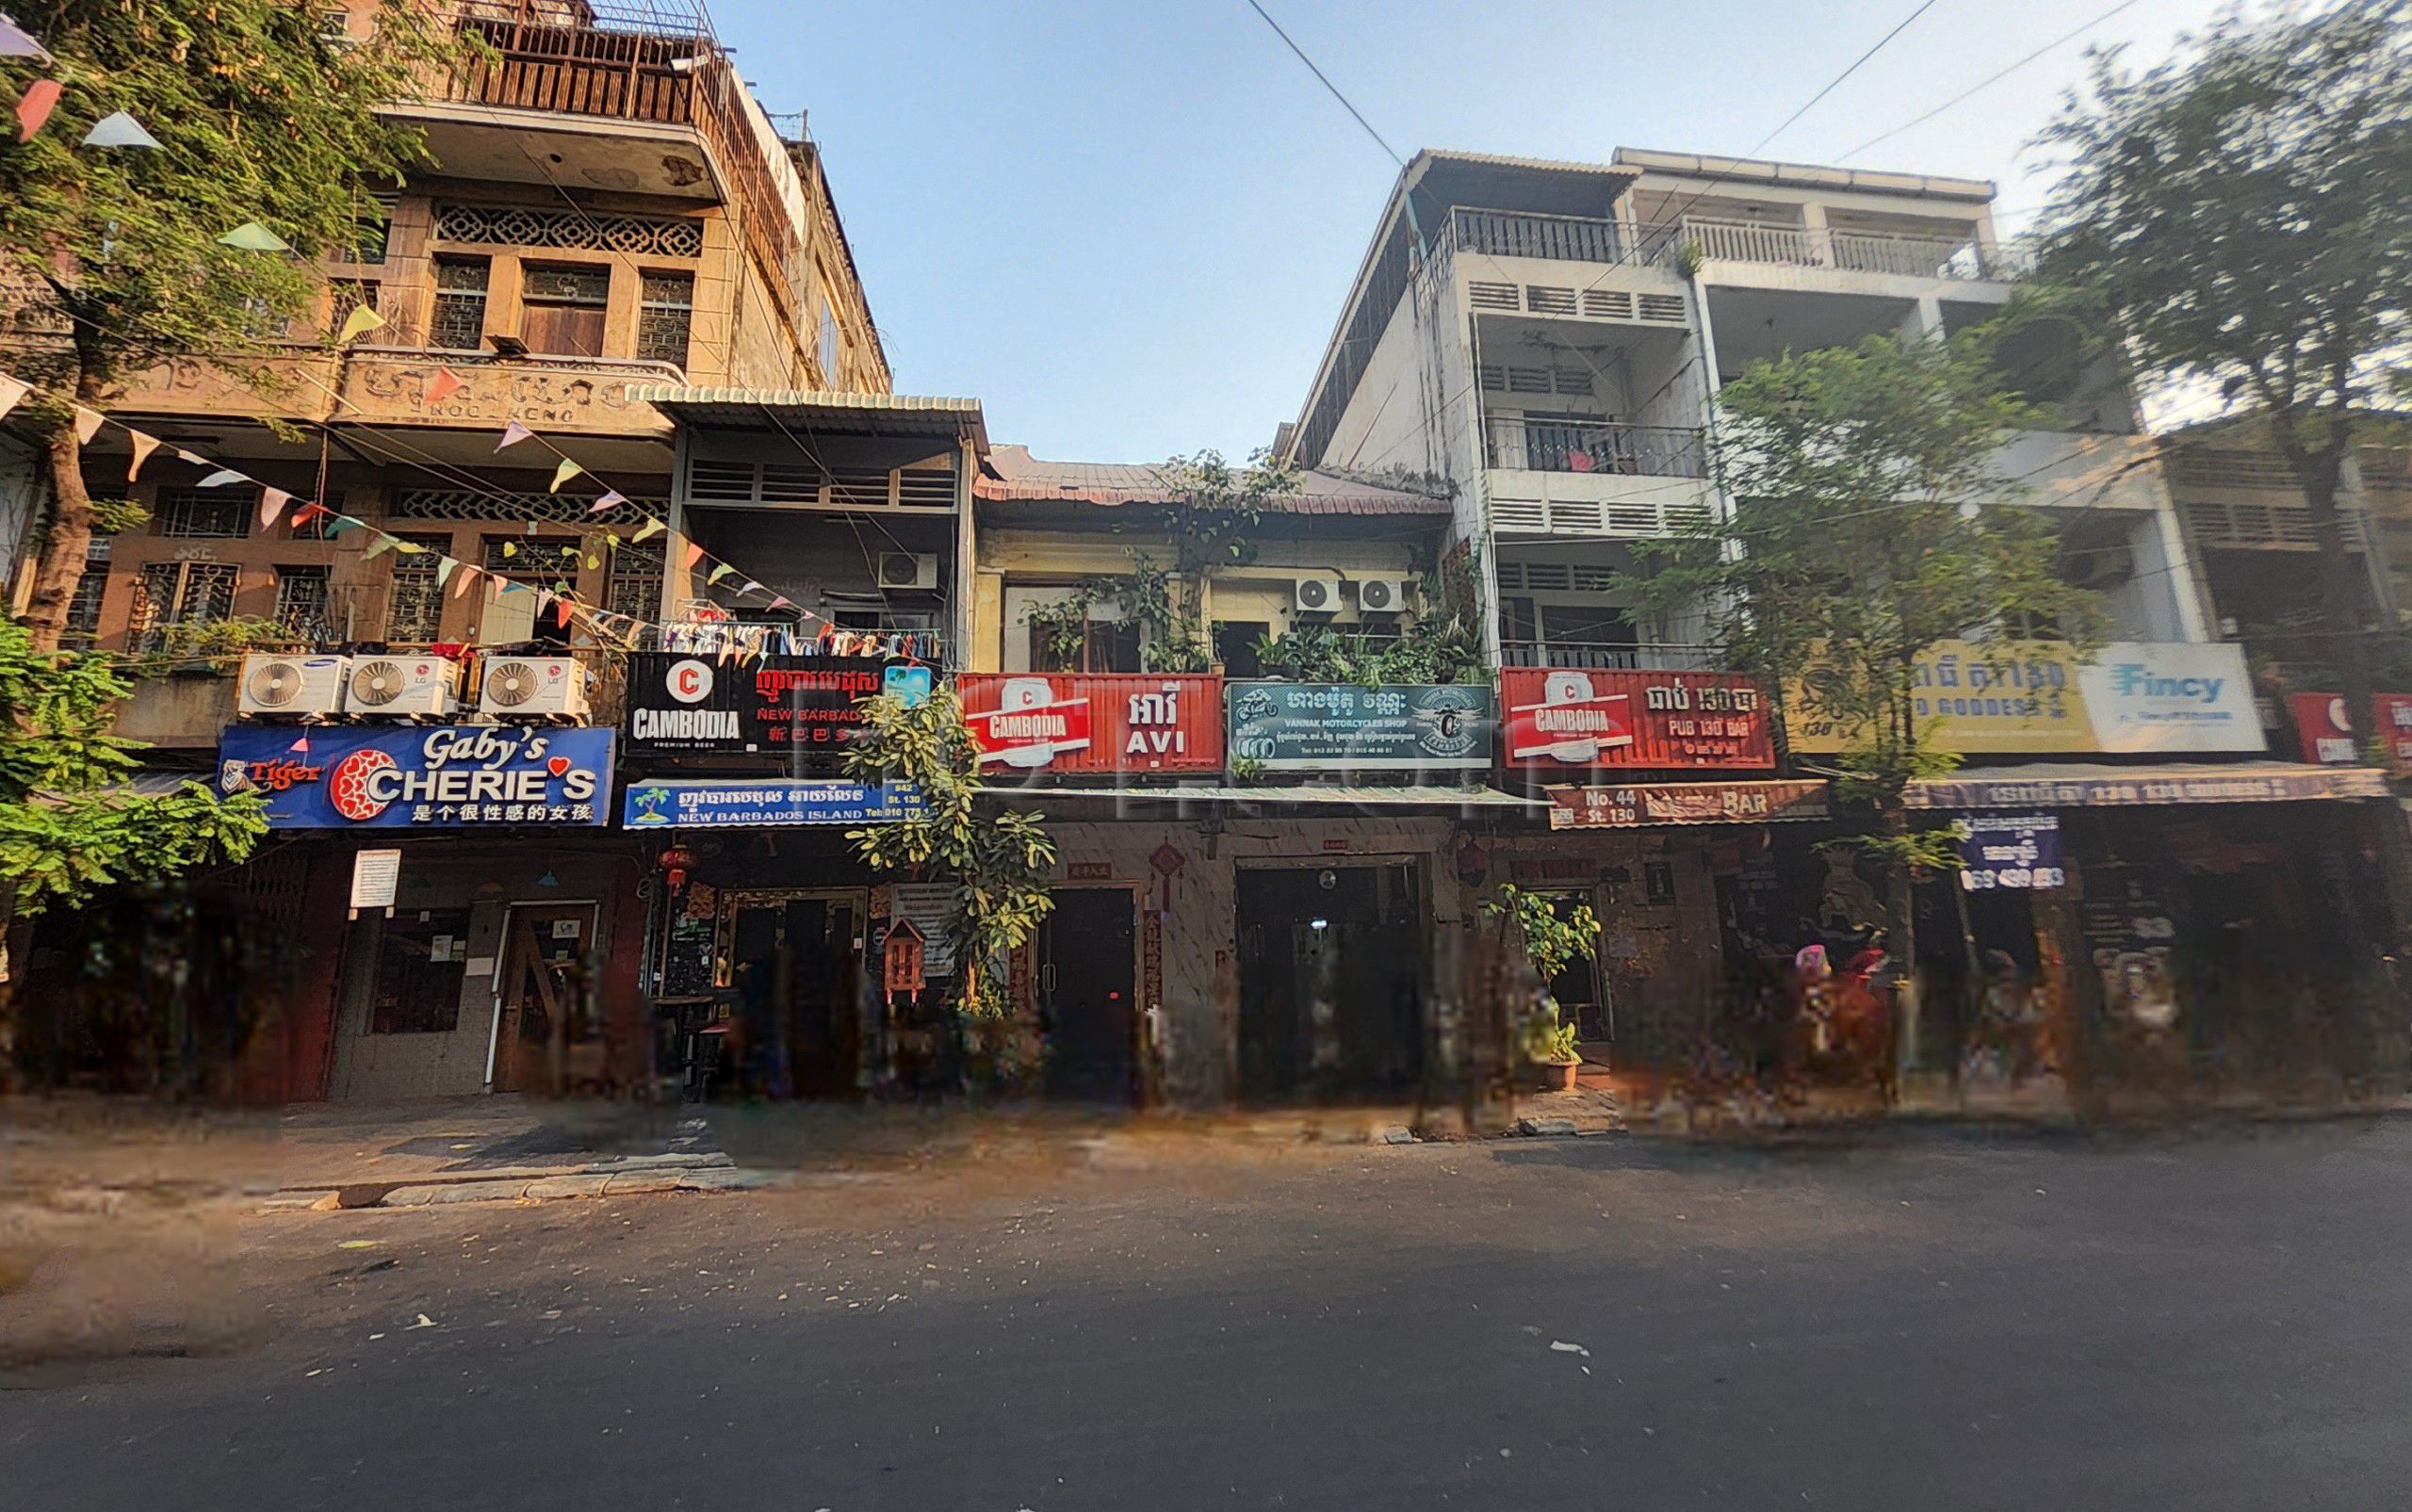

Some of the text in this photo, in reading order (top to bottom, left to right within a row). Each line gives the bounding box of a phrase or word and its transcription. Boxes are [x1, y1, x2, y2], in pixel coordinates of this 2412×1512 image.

[2108, 663, 2225, 704] Fincy
[633, 707, 741, 740] CAMBODIA
[757, 707, 867, 723] NEW BARBAD
[1284, 719, 1320, 727] VANNAK
[1322, 719, 1383, 727] MOTORCYCLES
[1384, 719, 1408, 727] SHOP
[1535, 709, 1609, 732] CAMBODIA
[768, 725, 871, 742] 新巴巴多
[989, 714, 1067, 739] CAMBODIA
[1669, 720, 1750, 737] PUB 130 BAR
[423, 726, 548, 769] Gaby's
[1126, 731, 1184, 754] AVI
[249, 758, 322, 790] Tiger
[888, 795, 921, 804] St. 130
[1586, 790, 1613, 806] No.
[1616, 789, 1638, 805] 44
[1721, 790, 1768, 815] BAR
[412, 804, 595, 822] 是个很性感的女孩
[677, 809, 862, 822] NEW BARBADOS ISLAND
[884, 808, 903, 817] 010
[1588, 809, 1607, 822] St.
[1609, 808, 1635, 821] 130
